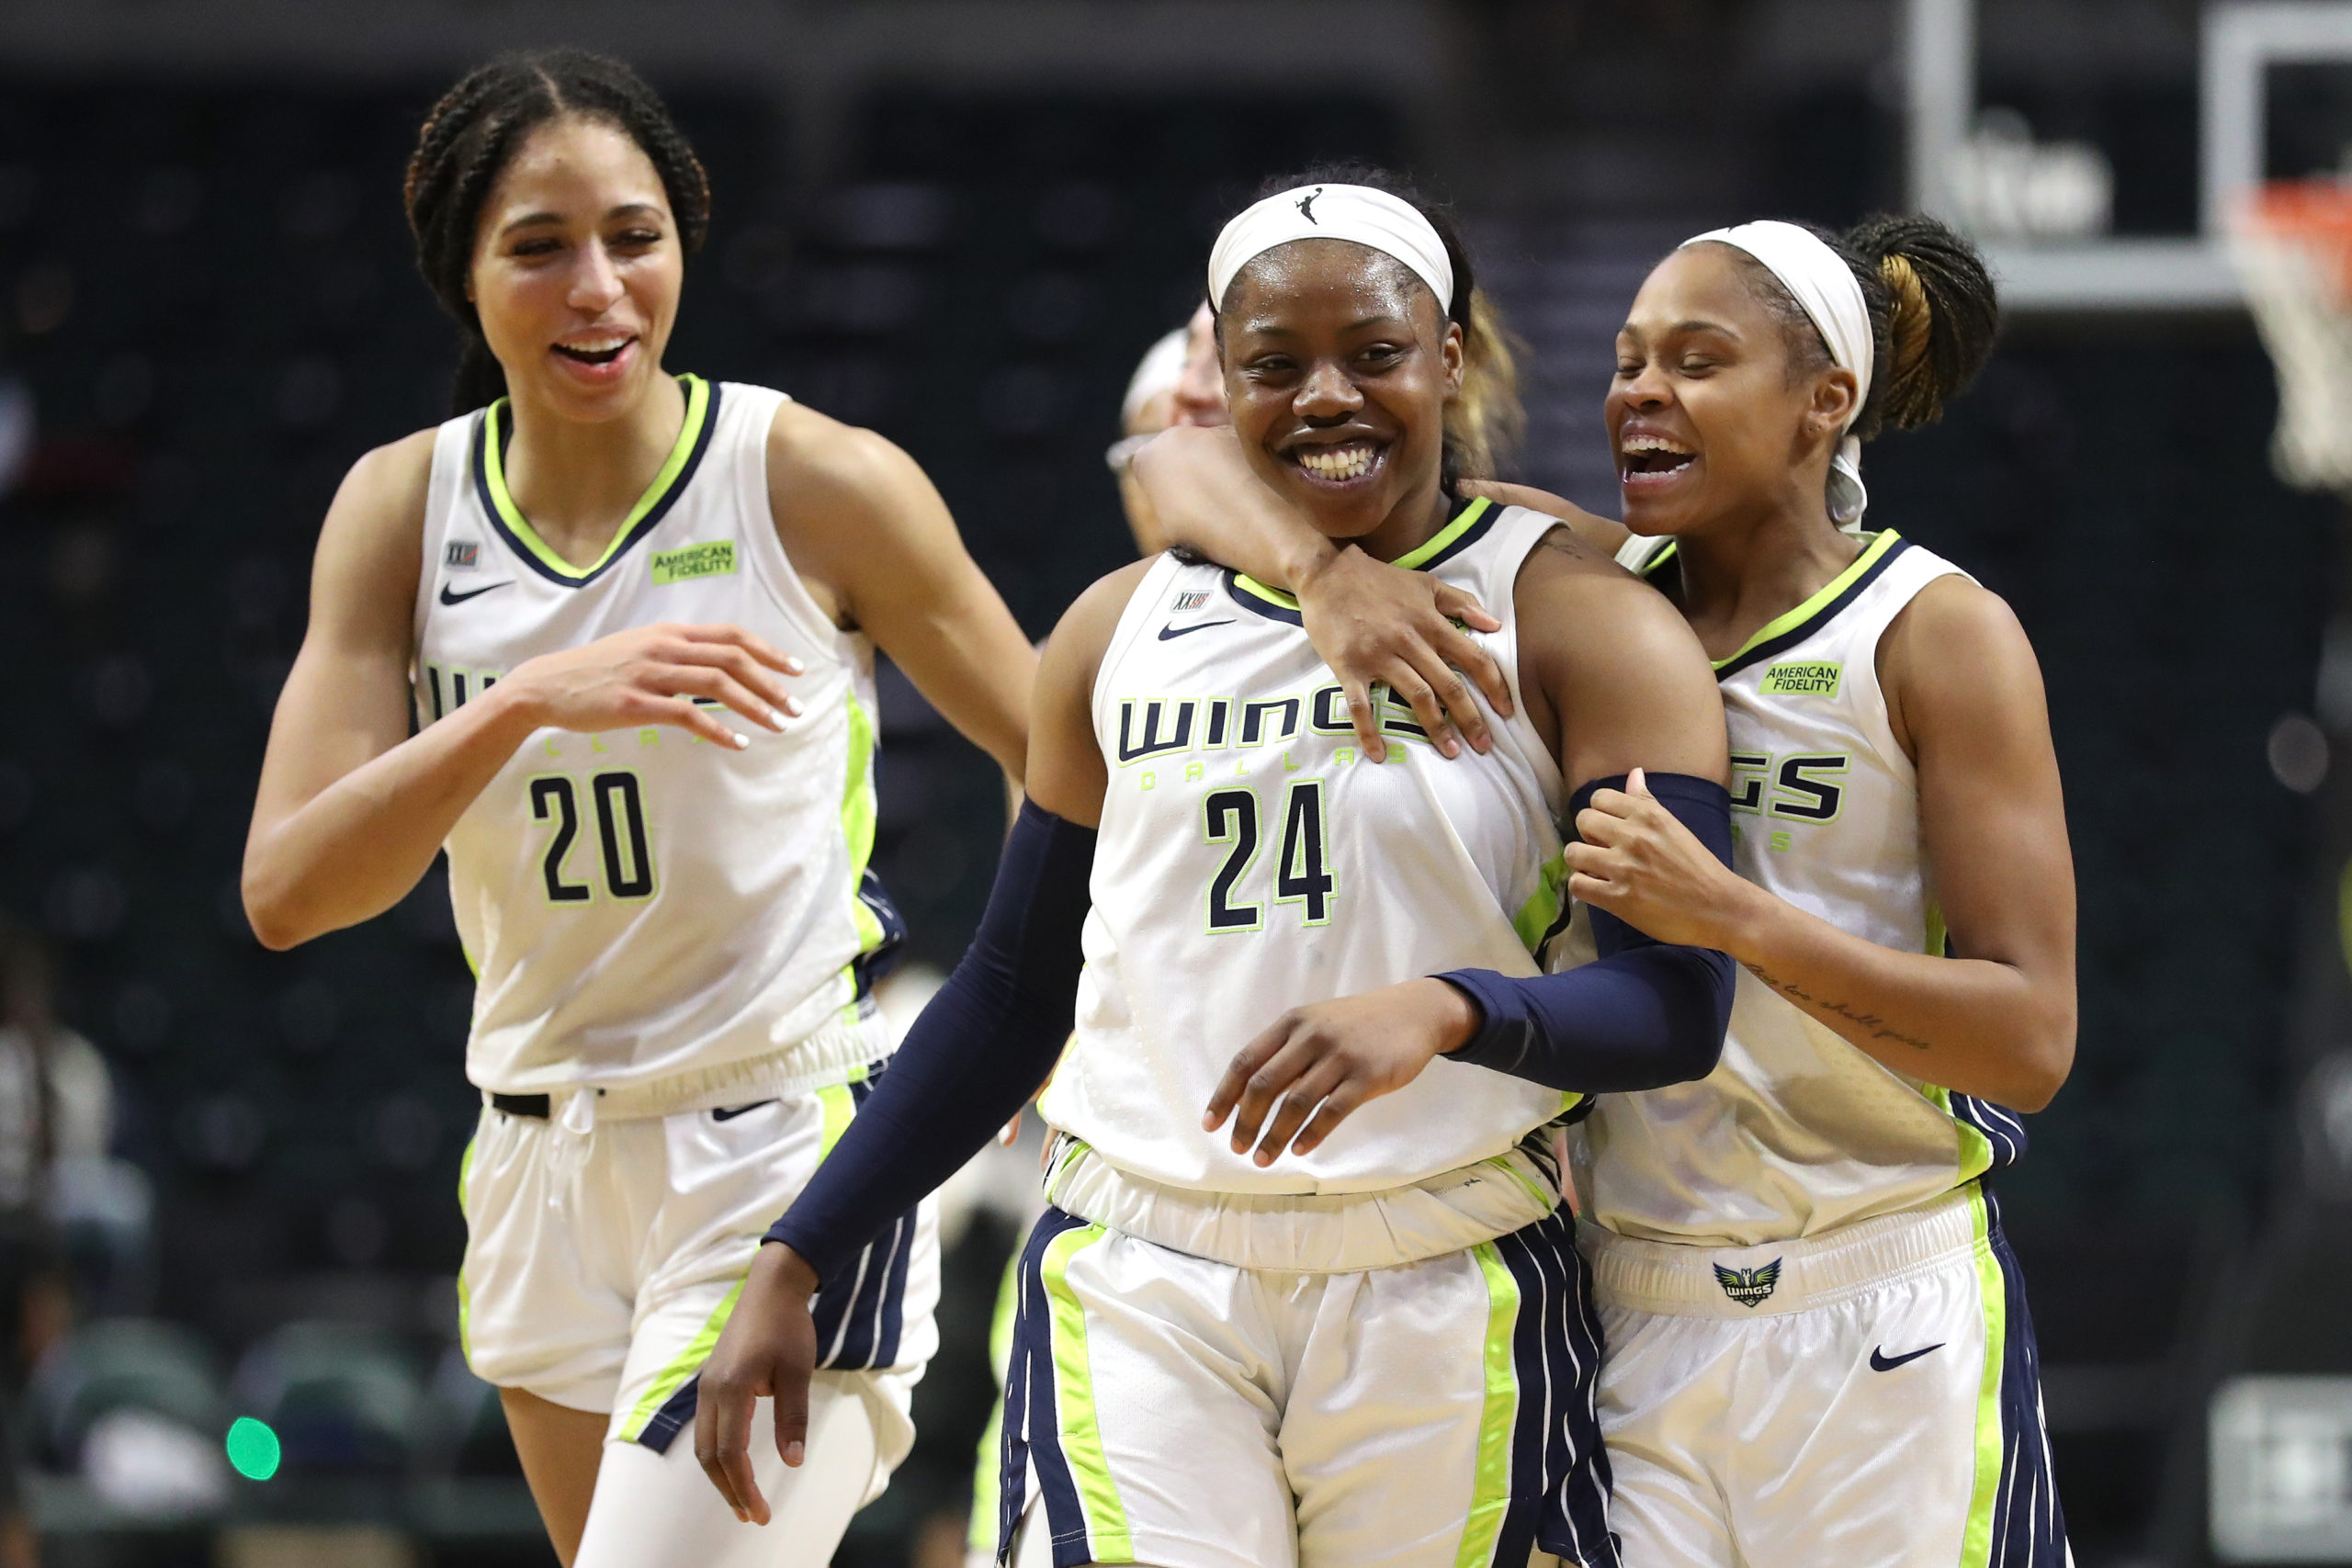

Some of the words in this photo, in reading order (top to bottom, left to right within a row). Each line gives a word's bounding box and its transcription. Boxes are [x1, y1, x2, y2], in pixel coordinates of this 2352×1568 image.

[653, 546, 733, 570] AMERICAN
[668, 558, 733, 580] FIDELITY
[1766, 666, 1838, 680] AMERICAN
[1773, 678, 1835, 693] FIDELITY
[1140, 744, 1408, 791] DALLAS
[526, 767, 660, 908] 20
[1201, 777, 1340, 935] 24
[1727, 1283, 1772, 1296] WINGS
